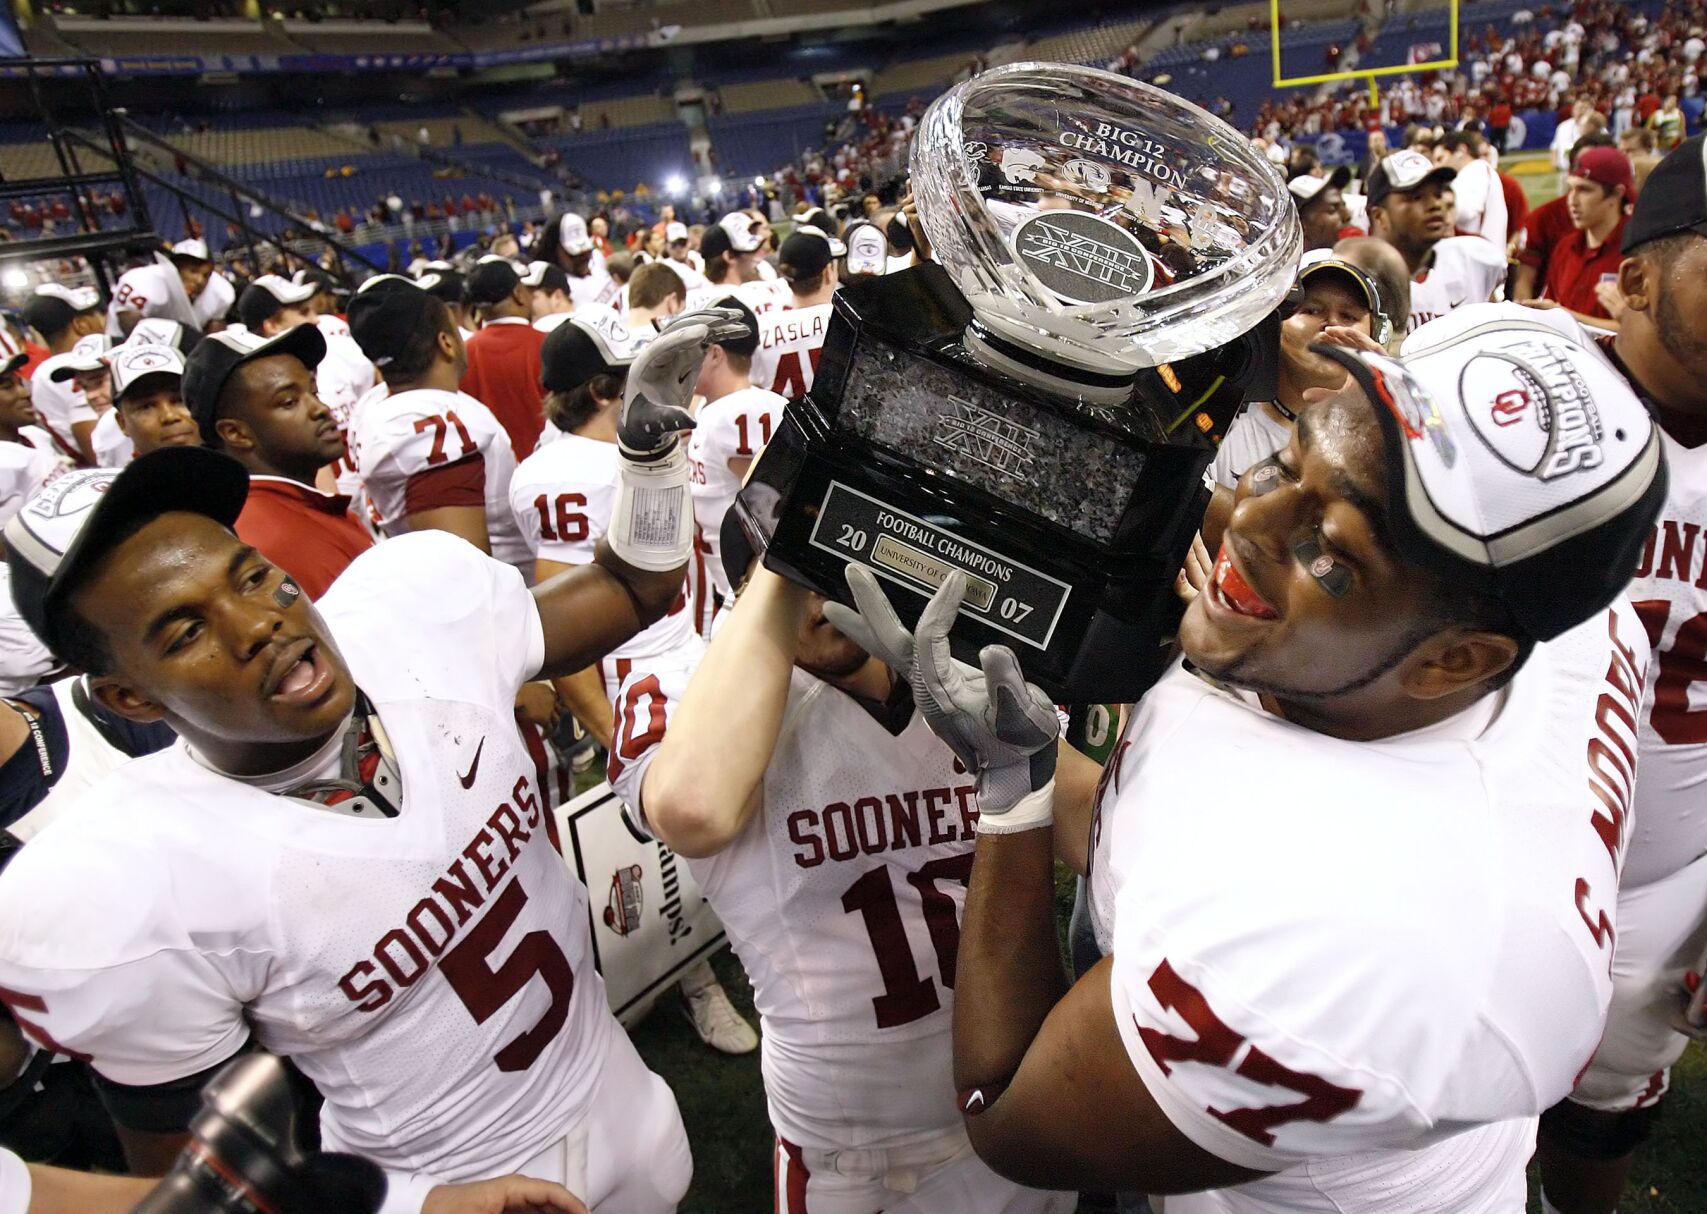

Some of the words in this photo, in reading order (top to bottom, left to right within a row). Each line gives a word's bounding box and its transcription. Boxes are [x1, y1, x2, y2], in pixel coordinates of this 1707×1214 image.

[1059, 131, 1189, 190] CHAMPION
[1096, 122, 1138, 146] BIG
[1143, 140, 1165, 159] 12
[1071, 247, 1126, 272] CONFERENCE
[762, 315, 831, 350] ZASLA
[770, 346, 824, 402] 4
[412, 409, 478, 465] 71
[735, 412, 772, 455] 11
[976, 428, 1022, 454] CONFERENCE
[533, 492, 590, 543] 16
[836, 523, 867, 552] 20
[876, 510, 935, 549] FOOTBALL
[937, 538, 1013, 582] CHAMPIONS
[880, 545, 926, 572] UNIVERSITY
[927, 567, 941, 577] OF
[1000, 597, 1034, 624] 07
[33, 729, 53, 777] CONFERENCE
[787, 785, 980, 869] SOONER
[338, 775, 541, 1013] SOONERS
[657, 841, 692, 946] amps!
[437, 875, 575, 1073] 5
[1132, 956, 1364, 1148] 77
